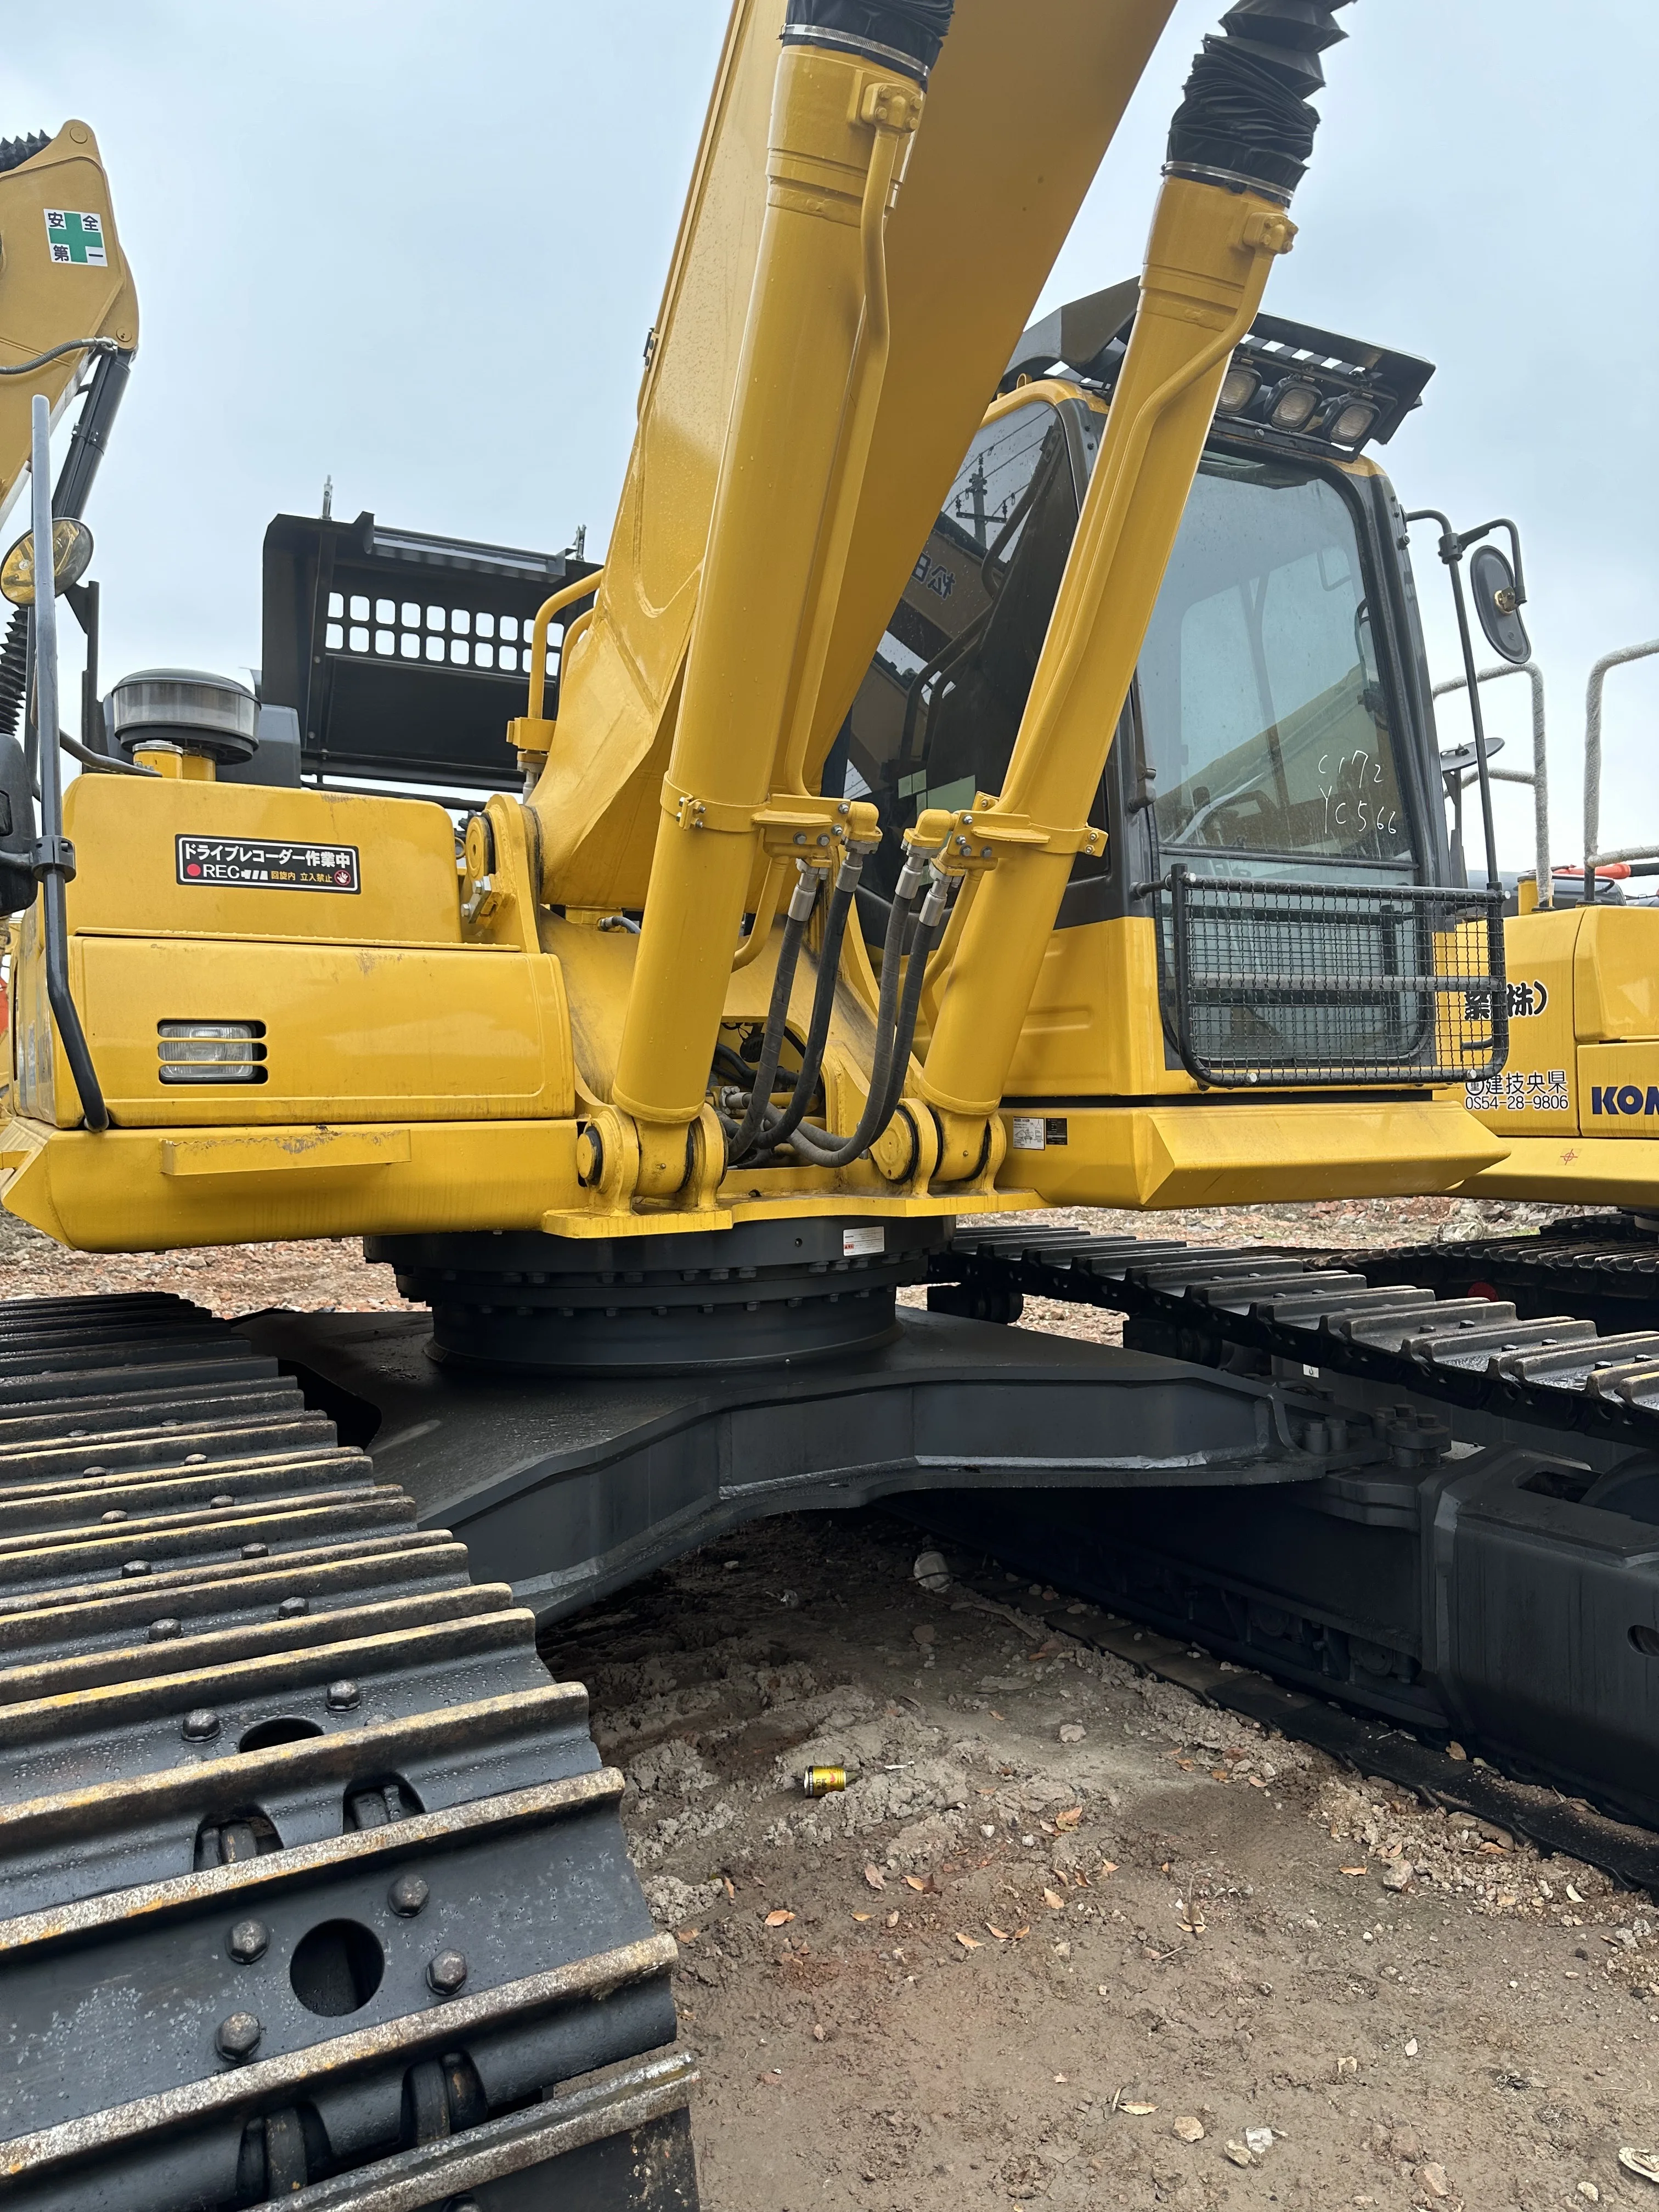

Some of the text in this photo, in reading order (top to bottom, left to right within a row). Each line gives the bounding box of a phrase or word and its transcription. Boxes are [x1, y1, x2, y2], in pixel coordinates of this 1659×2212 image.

[185, 843, 351, 869] ドライブレコーダー作業中
[203, 864, 333, 883] REC 回旋内 立入禁止
